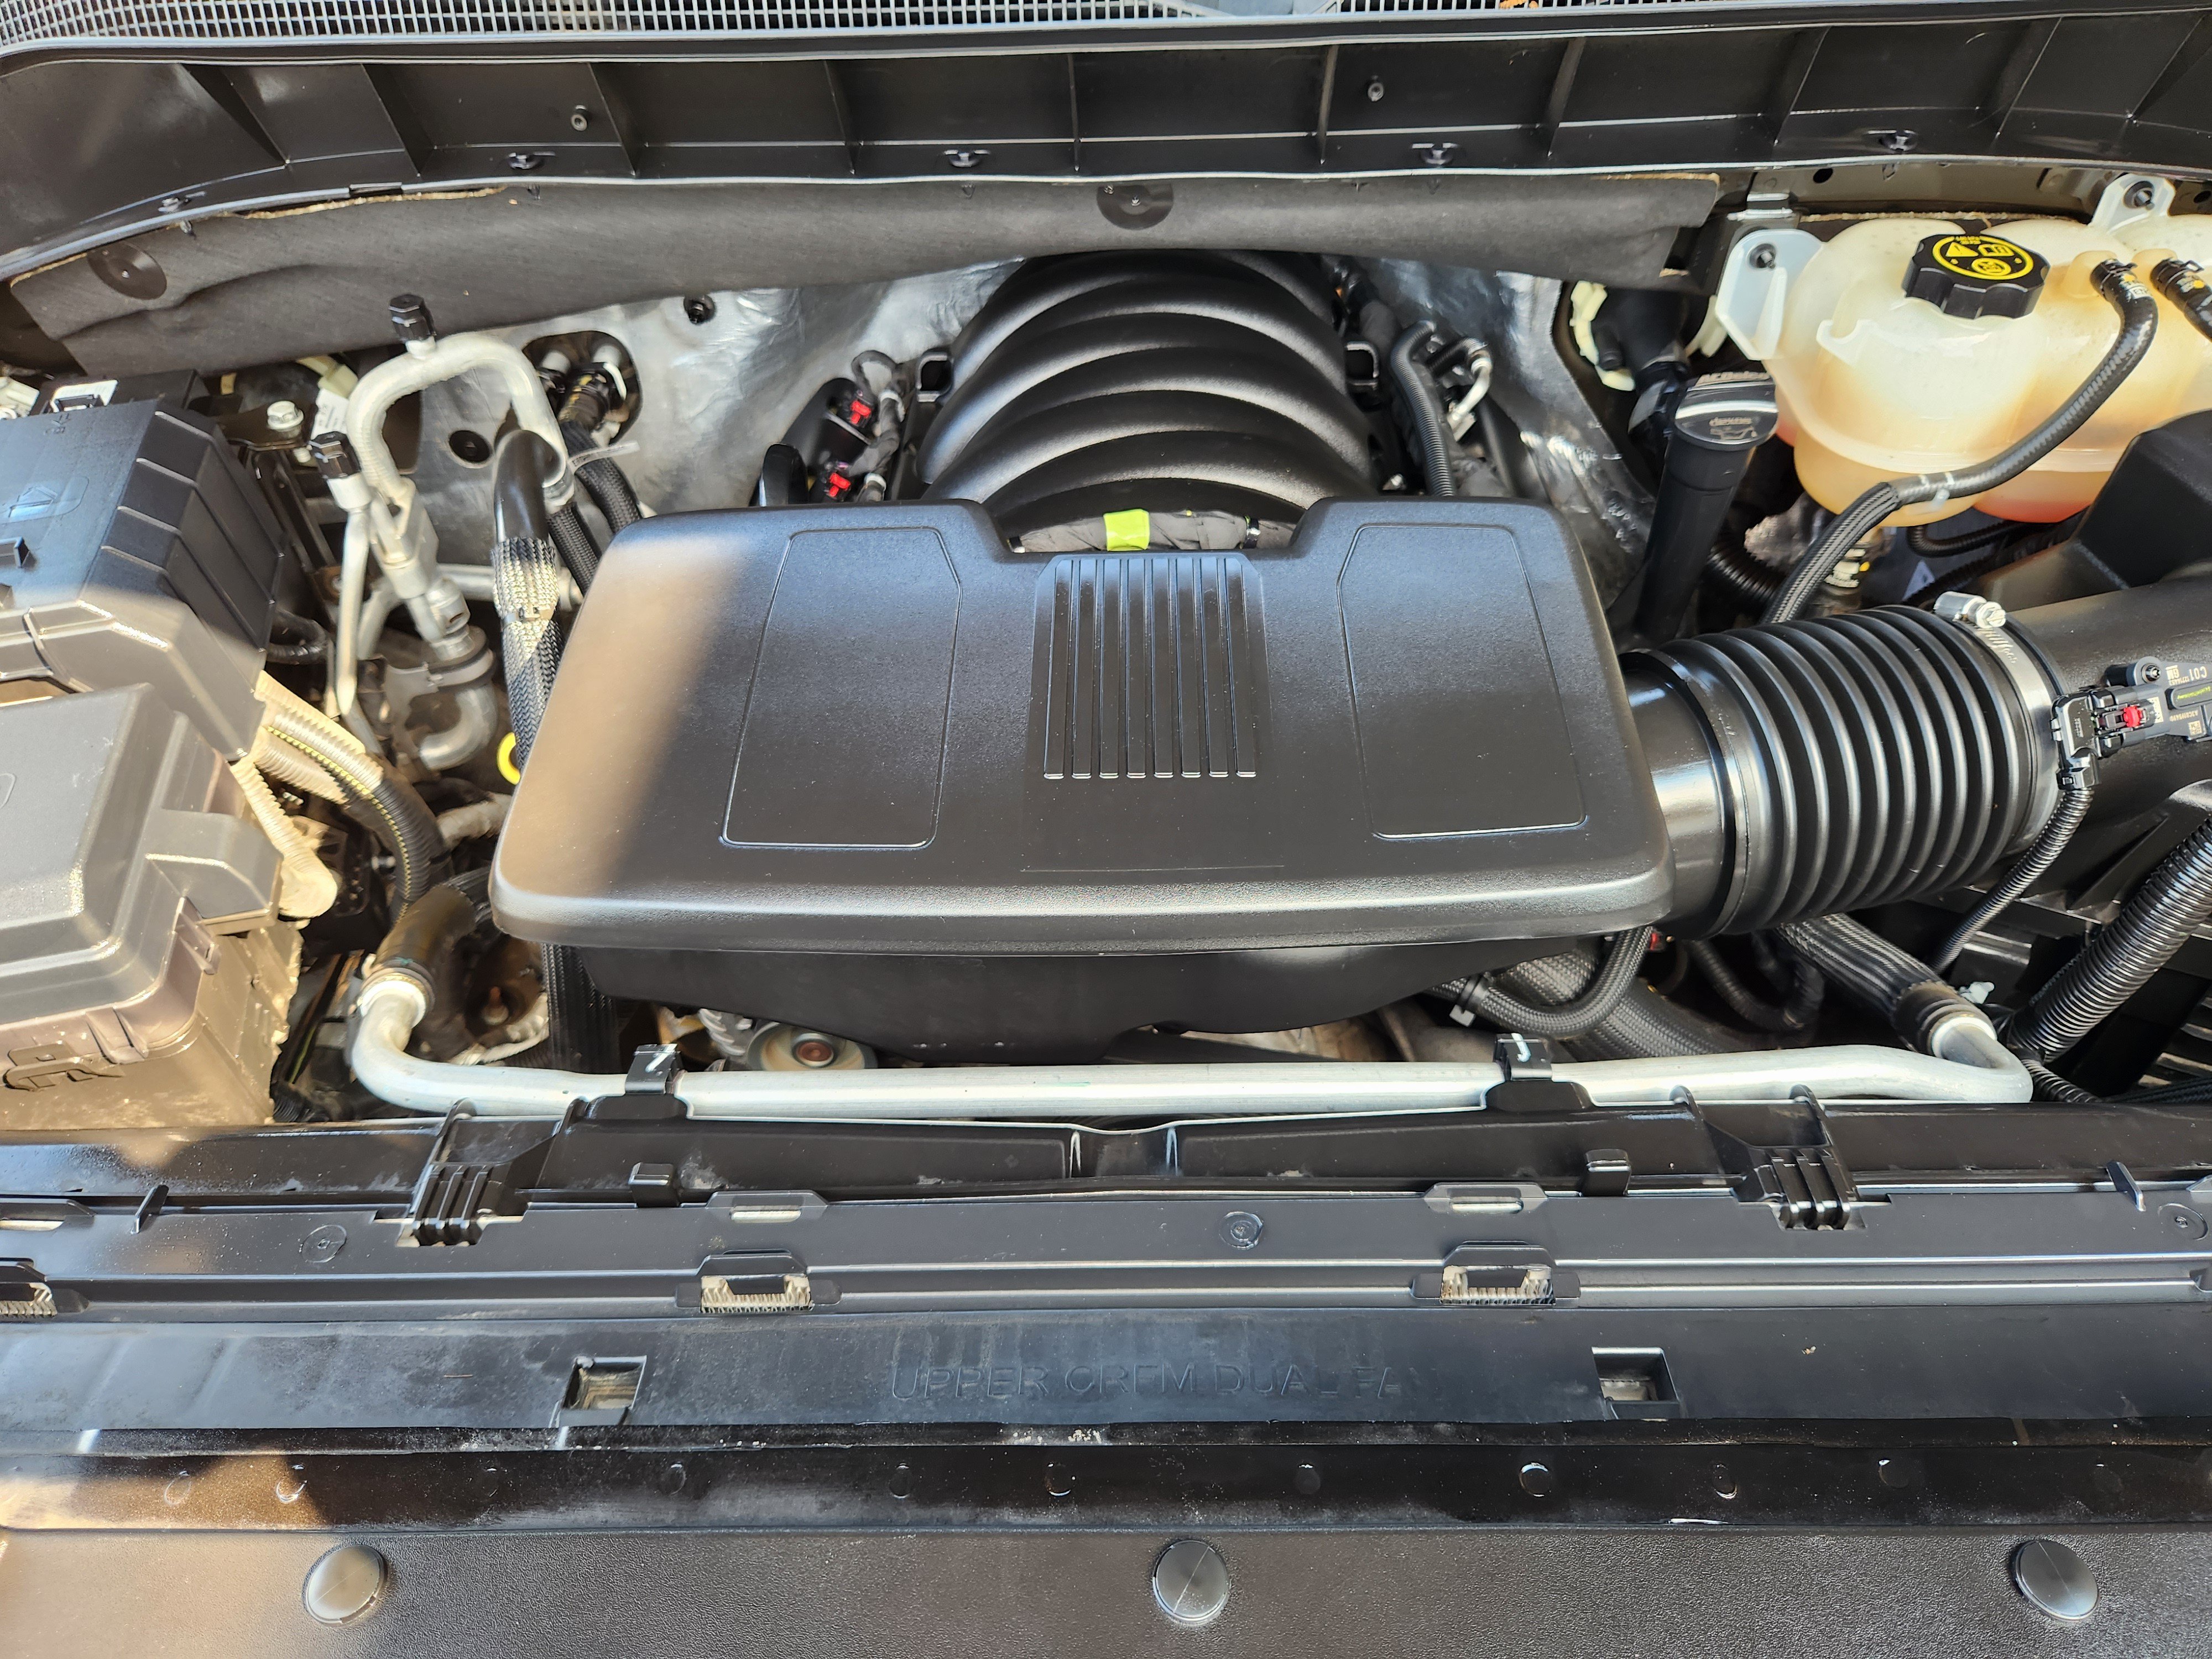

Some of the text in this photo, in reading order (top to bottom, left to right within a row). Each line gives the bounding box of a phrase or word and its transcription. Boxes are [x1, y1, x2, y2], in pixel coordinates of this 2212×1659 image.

[2166, 667, 2179, 680] GM
[2189, 666, 2207, 681] C01
[892, 1365, 1050, 1400] UPPER
[1214, 1363, 1339, 1396] DUAL
